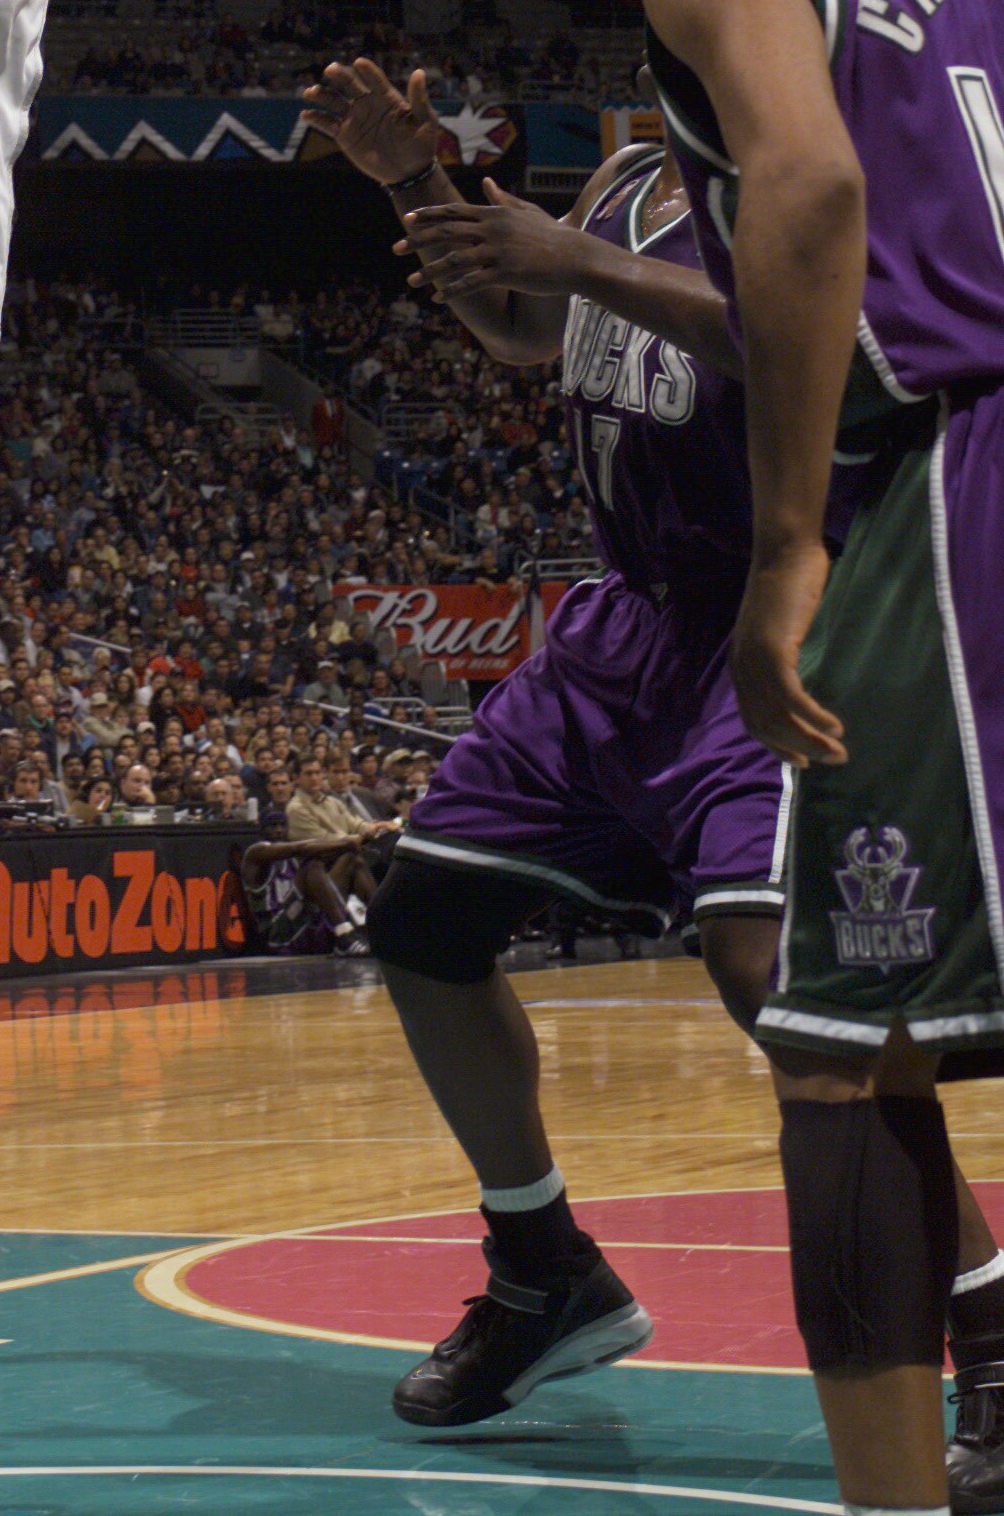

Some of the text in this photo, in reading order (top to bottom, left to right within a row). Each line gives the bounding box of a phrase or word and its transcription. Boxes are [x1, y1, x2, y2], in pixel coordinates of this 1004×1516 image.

[562, 293, 696, 426] UCKS
[349, 588, 526, 655] Bud
[840, 916, 925, 960] BUCKS
